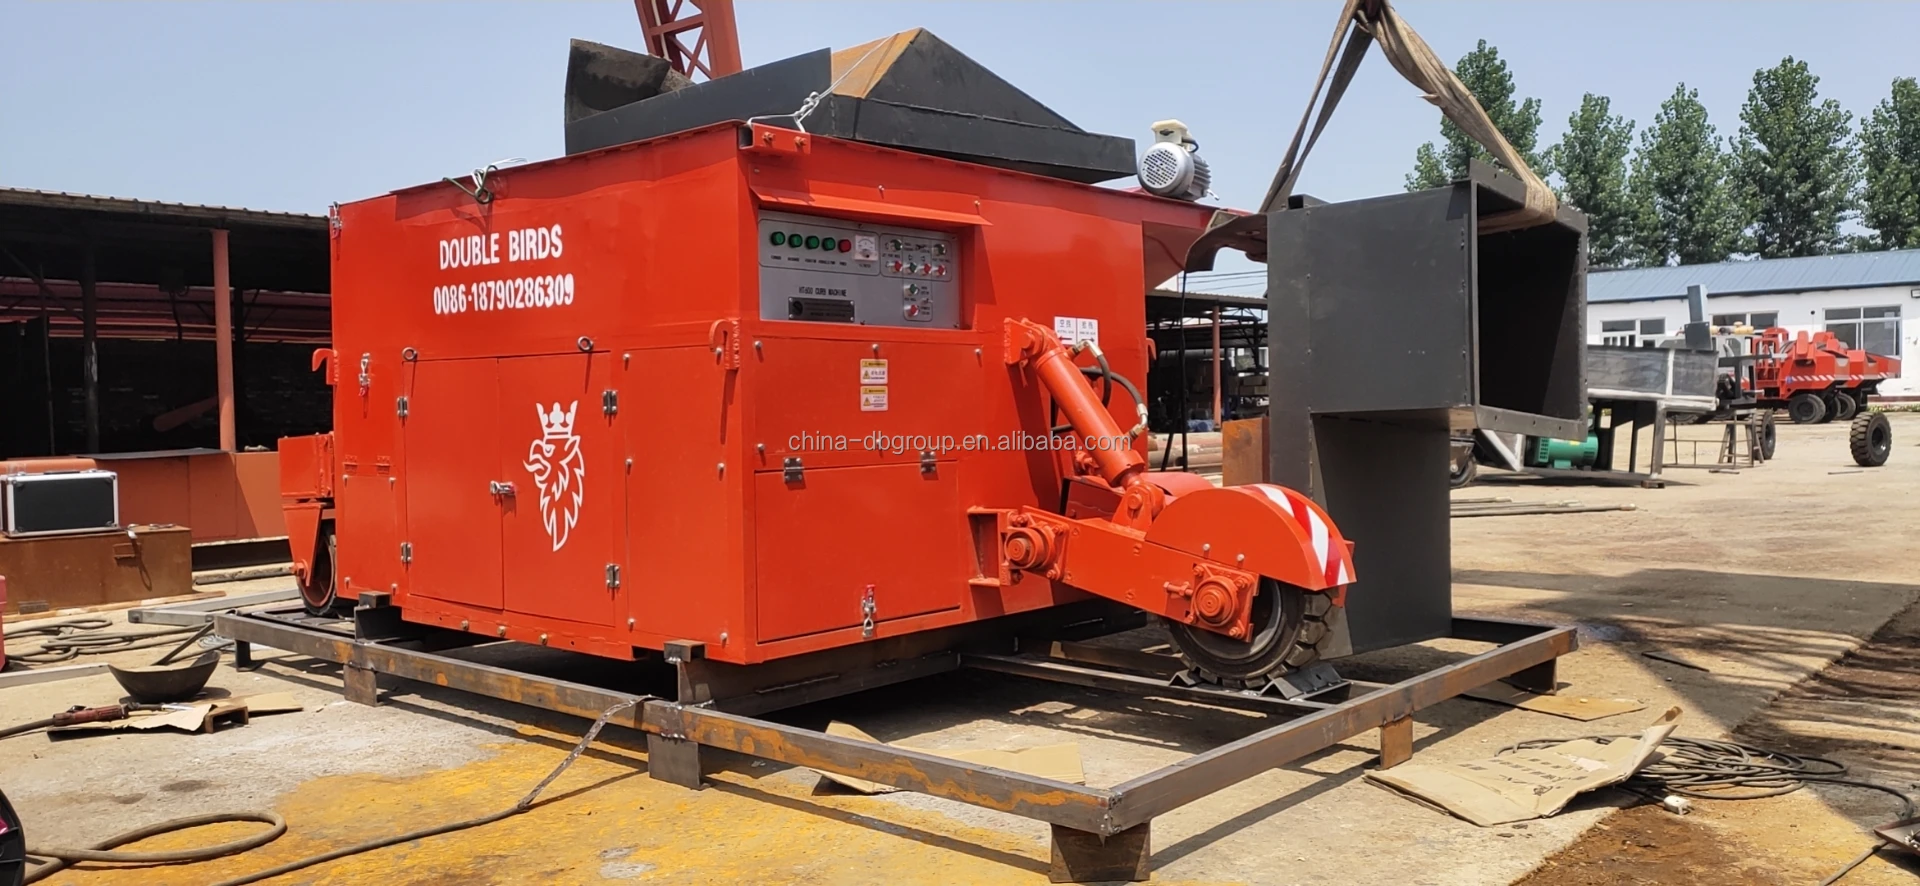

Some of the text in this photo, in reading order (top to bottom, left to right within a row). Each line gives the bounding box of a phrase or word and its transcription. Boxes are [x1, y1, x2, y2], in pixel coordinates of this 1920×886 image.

[439, 223, 563, 270] DOUBLE BIRDS
[433, 273, 575, 315] 0086-18790286309
